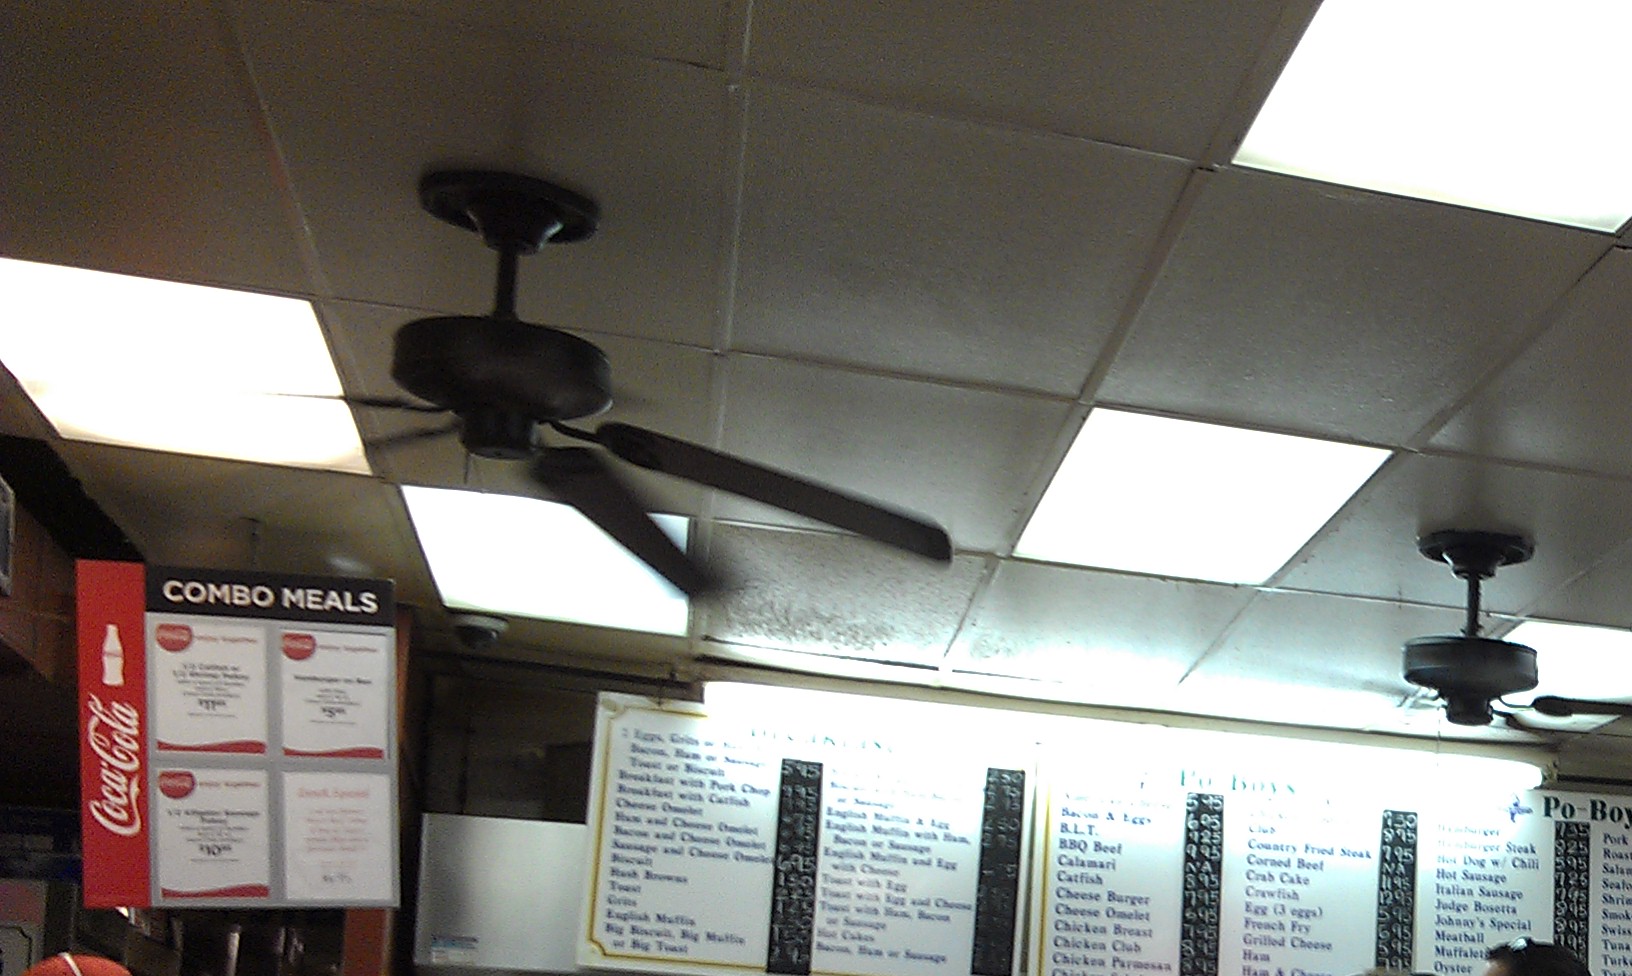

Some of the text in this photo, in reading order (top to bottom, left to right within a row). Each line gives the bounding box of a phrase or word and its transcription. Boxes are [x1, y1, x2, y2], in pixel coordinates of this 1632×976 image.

[163, 581, 379, 614] COMBO MEALS
[87, 694, 142, 836] Coca-Cola
[1059, 838, 1122, 855] BBQ Beef
[1248, 840, 1297, 853] Country
[1603, 833, 1628, 845] Pork
[1506, 842, 1536, 854] Steak
[1058, 855, 1116, 870] Calamari
[1247, 855, 1323, 871] Corned Beef
[1464, 856, 1486, 867] Dog
[1512, 857, 1539, 869] Chili
[1057, 871, 1103, 885] Catfish
[1246, 871, 1310, 885] Crab Cake
[1437, 868, 1506, 884] Hot Sausage
[1056, 887, 1150, 906] Cheese Burger
[1245, 886, 1299, 900] Crawfish
[1436, 883, 1523, 899] Italian Sausage
[1055, 904, 1150, 921] Cheese Omelet
[1245, 902, 1267, 916] Egg
[1435, 899, 1517, 914] Judge Bosetta
[1054, 920, 1152, 938] Chicken Breast
[1244, 918, 1311, 934] French Fry
[1435, 914, 1531, 931] Johnny's Special
[1601, 924, 1632, 936] Swiss
[1053, 936, 1141, 952] Chicken Club
[1243, 934, 1332, 951] Grilled Cheese
[1435, 930, 1484, 943] Meatball
[1435, 946, 1490, 959] Muffalett
[1601, 939, 1630, 951] Tuna
[1052, 952, 1171, 971] Chicken Parmesan
[1243, 950, 1270, 962] Ham
[1434, 961, 1472, 974] Oyster
